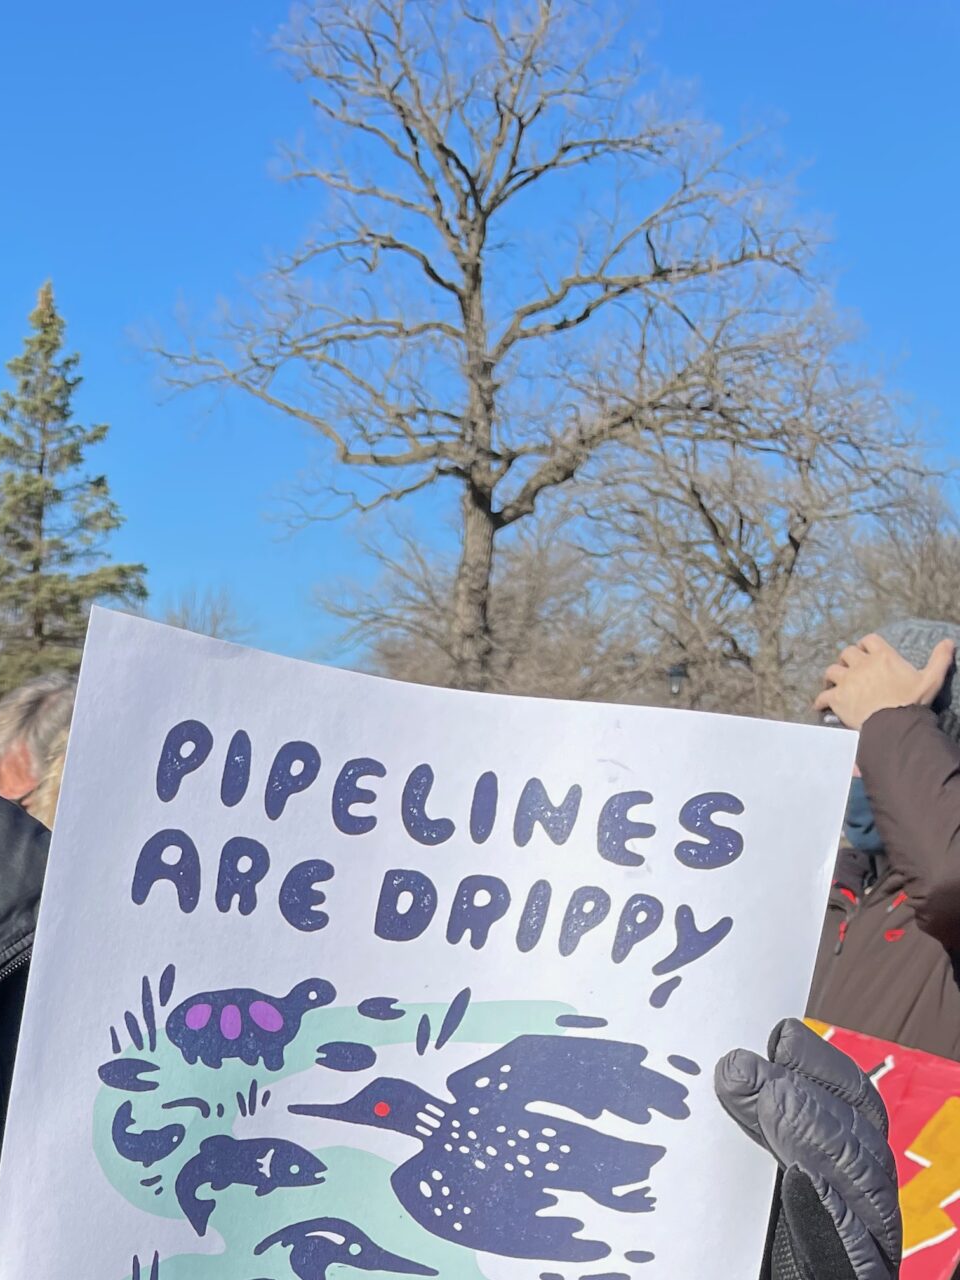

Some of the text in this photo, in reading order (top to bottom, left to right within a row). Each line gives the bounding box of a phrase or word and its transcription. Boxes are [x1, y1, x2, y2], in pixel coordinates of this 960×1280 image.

[156, 719, 744, 870] PIPELINES
[132, 828, 733, 975] ARE DRIPPY
